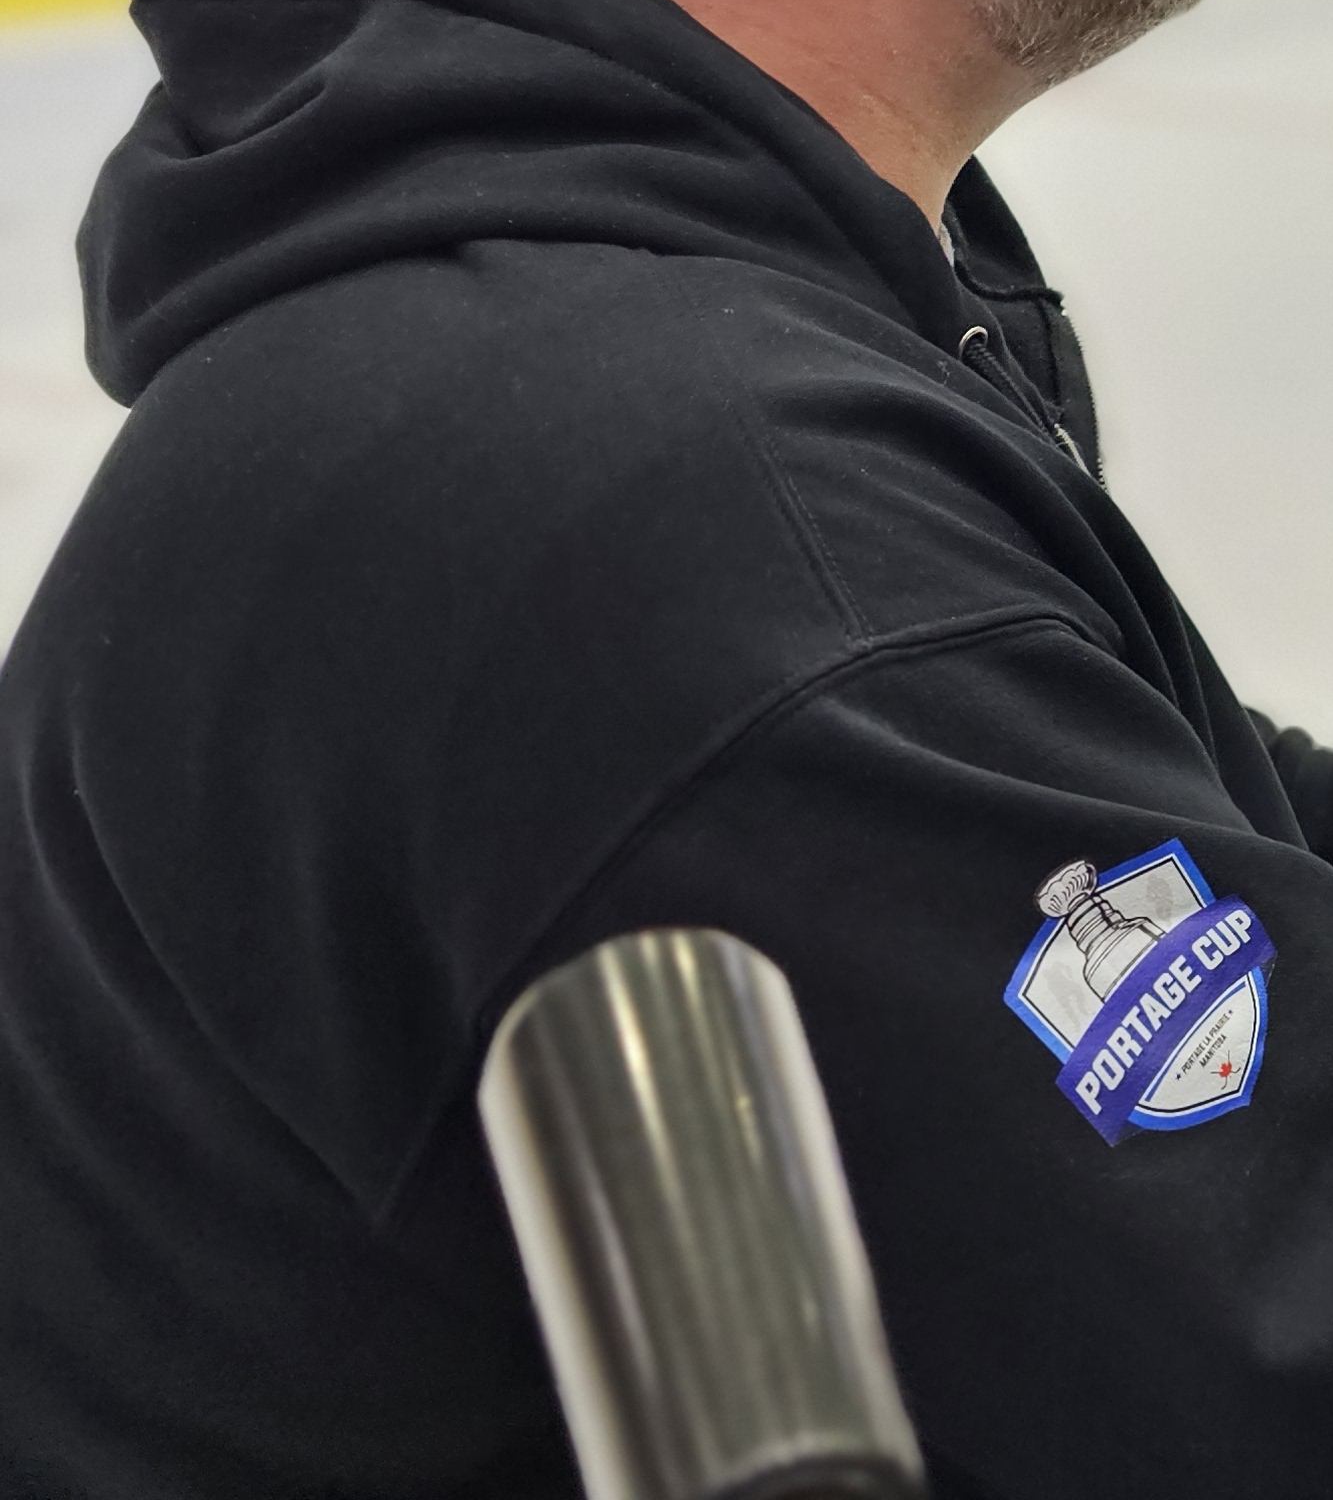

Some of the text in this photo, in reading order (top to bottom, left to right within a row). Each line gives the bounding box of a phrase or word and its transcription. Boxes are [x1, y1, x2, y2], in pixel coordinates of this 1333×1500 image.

[1075, 909, 1252, 1115] PORTAGE CUP
[1181, 1013, 1230, 1075] PORTAGE LA PRAIRIE
[1199, 1033, 1227, 1067] MANITOBA
